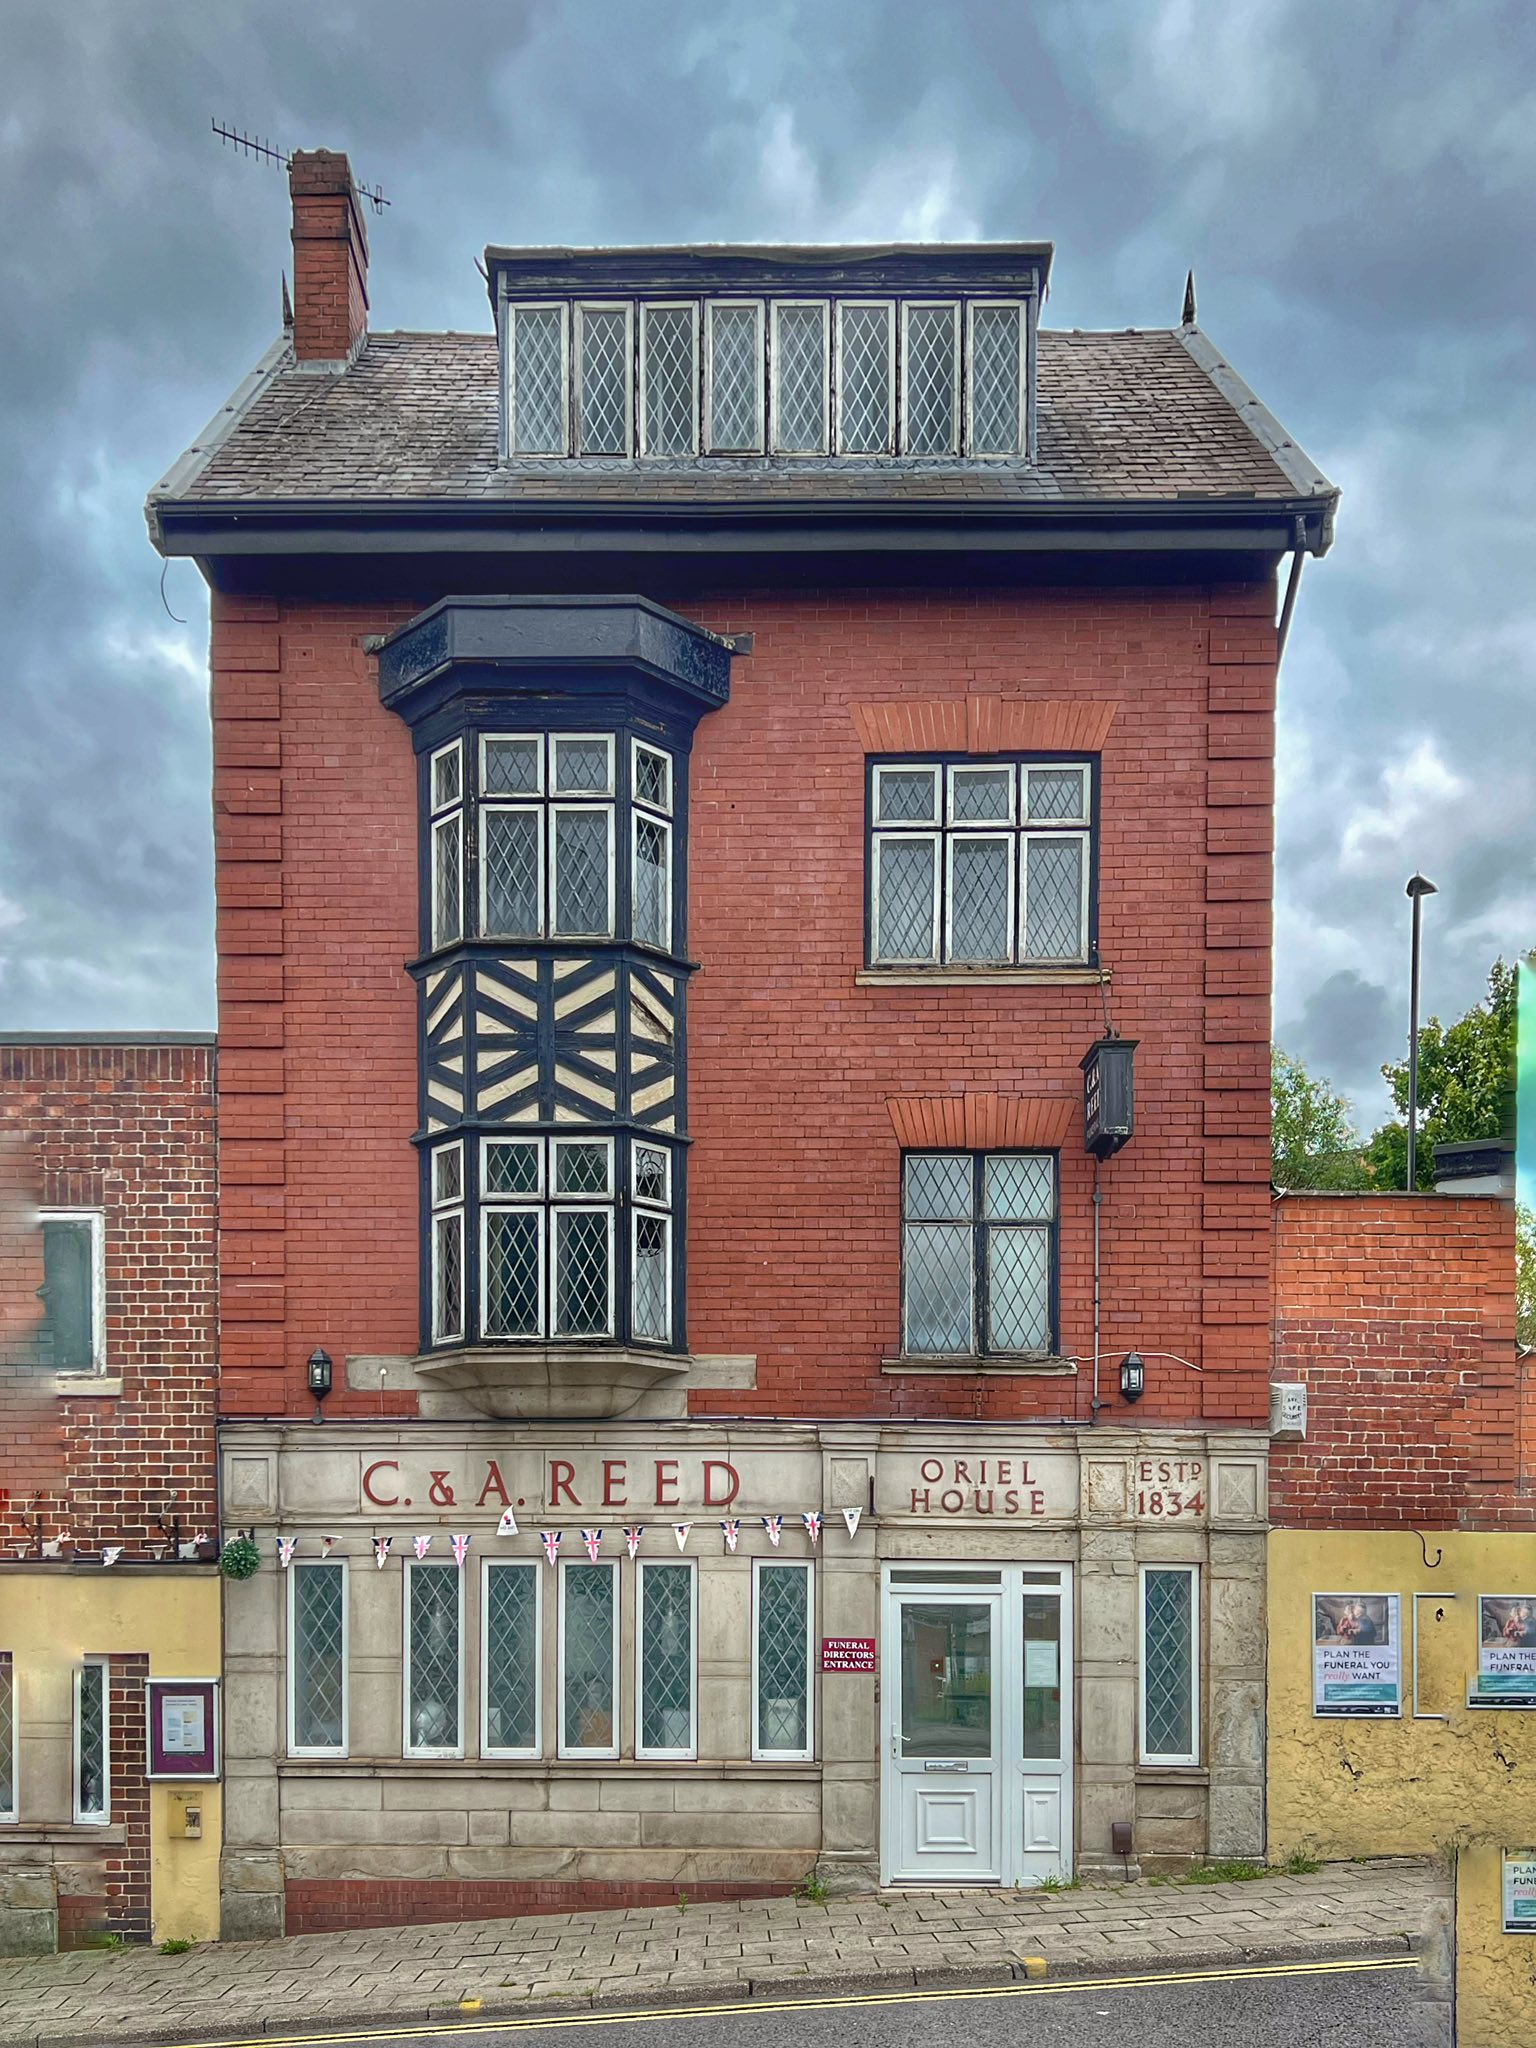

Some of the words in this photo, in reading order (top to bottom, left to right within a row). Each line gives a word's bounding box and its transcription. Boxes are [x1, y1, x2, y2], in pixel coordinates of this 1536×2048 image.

[920, 1458, 1036, 1485] ORIEL
[548, 1459, 740, 1506] REED
[910, 1488, 1046, 1515] HOUSE
[1137, 1490, 1206, 1516] 1834
[828, 1641, 869, 1649] FUNERAL
[823, 1650, 874, 1659] DIRECTORS
[1323, 1650, 1350, 1659] PLAN
[1352, 1650, 1371, 1659] THE
[1489, 1652, 1516, 1661] PLAN
[1518, 1652, 1536, 1661] THE
[823, 1660, 874, 1669] ENTRANCE
[1323, 1661, 1369, 1670] FUNERAL
[1370, 1661, 1391, 1670] YOU
[1490, 1663, 1535, 1672] FUNERAL
[1323, 1671, 1349, 1682] really
[1352, 1672, 1382, 1681] WANT
